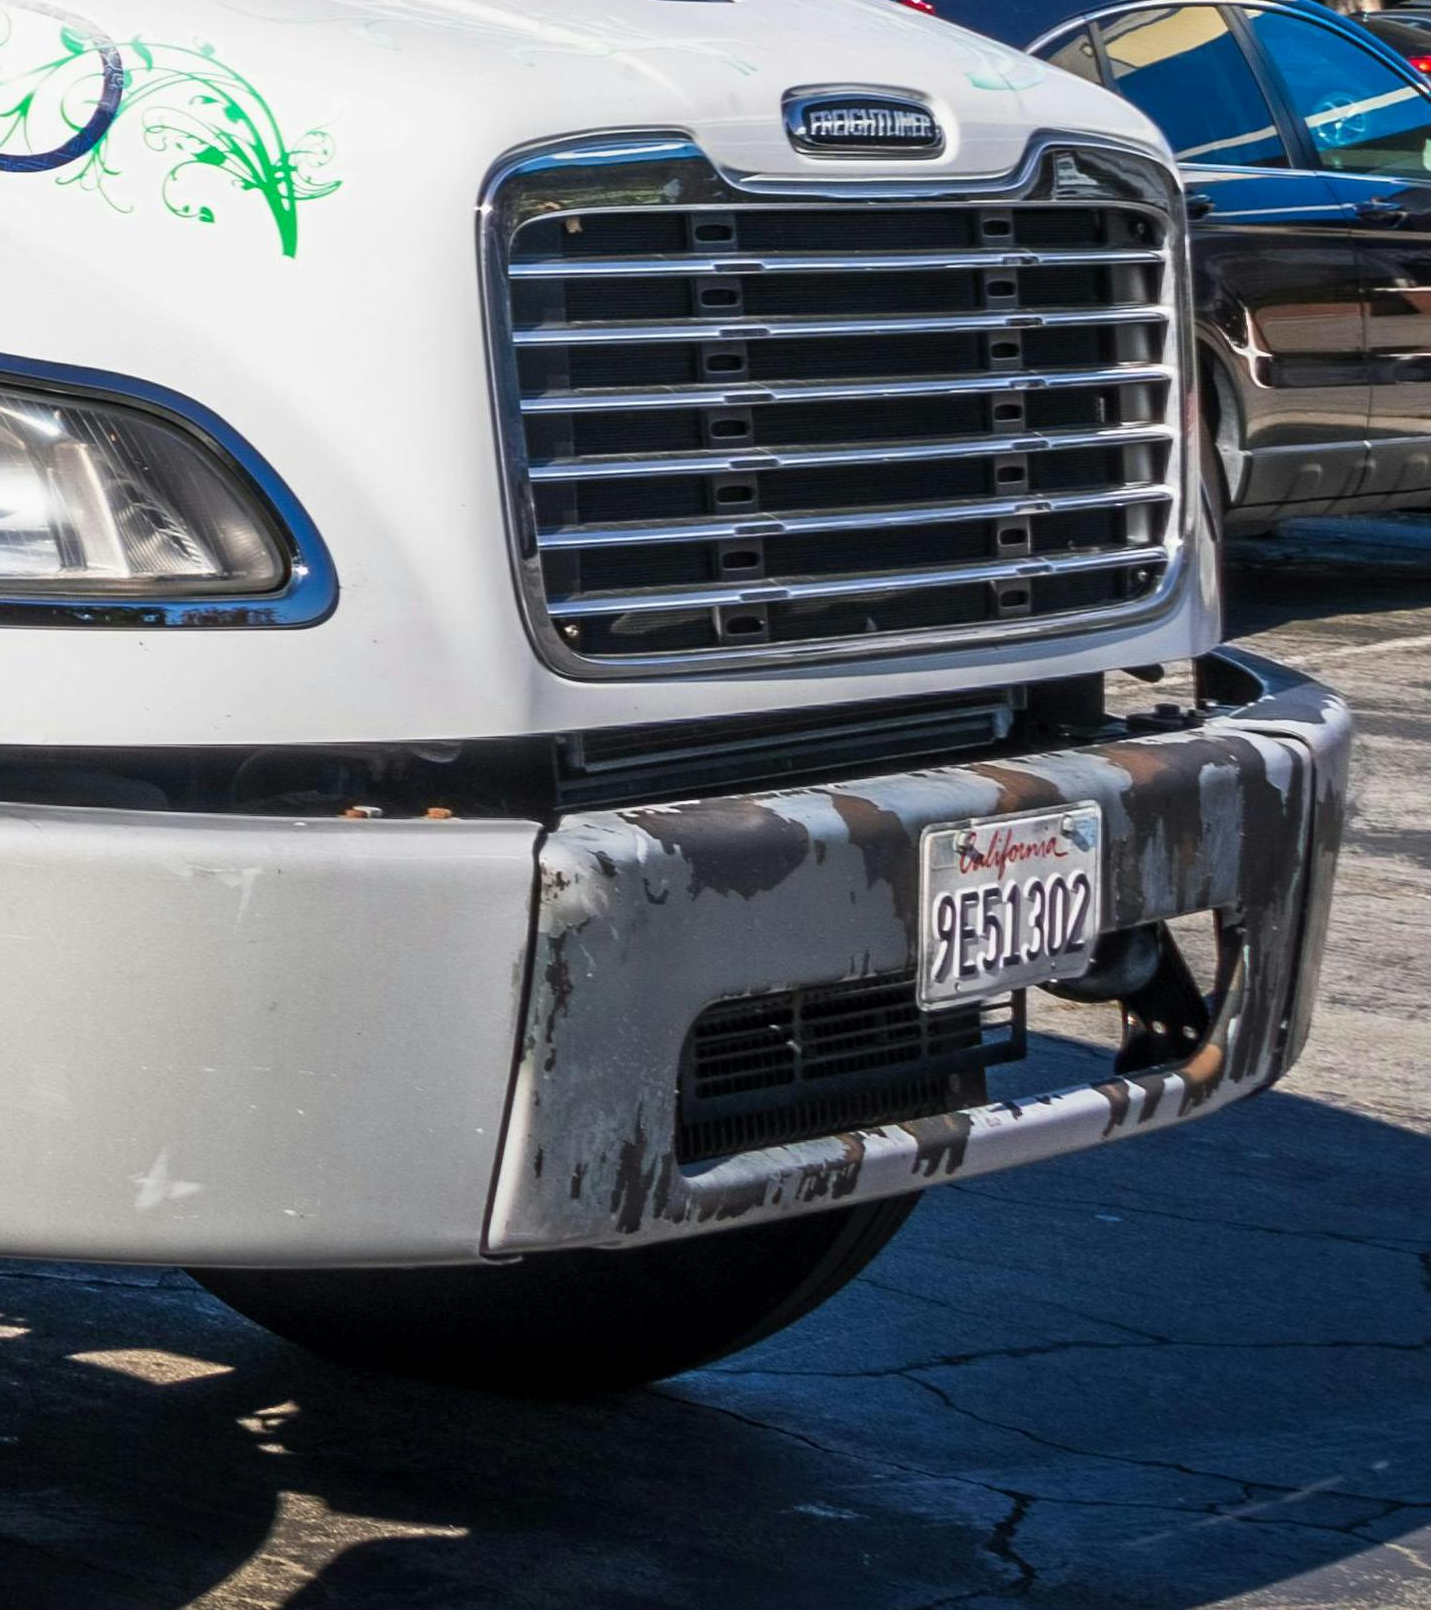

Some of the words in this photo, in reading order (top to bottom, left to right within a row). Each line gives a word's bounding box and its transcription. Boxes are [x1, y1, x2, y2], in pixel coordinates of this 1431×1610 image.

[809, 106, 934, 138] FREIGHTLINER
[958, 827, 1069, 881] California
[932, 869, 1092, 985] 9E51302
